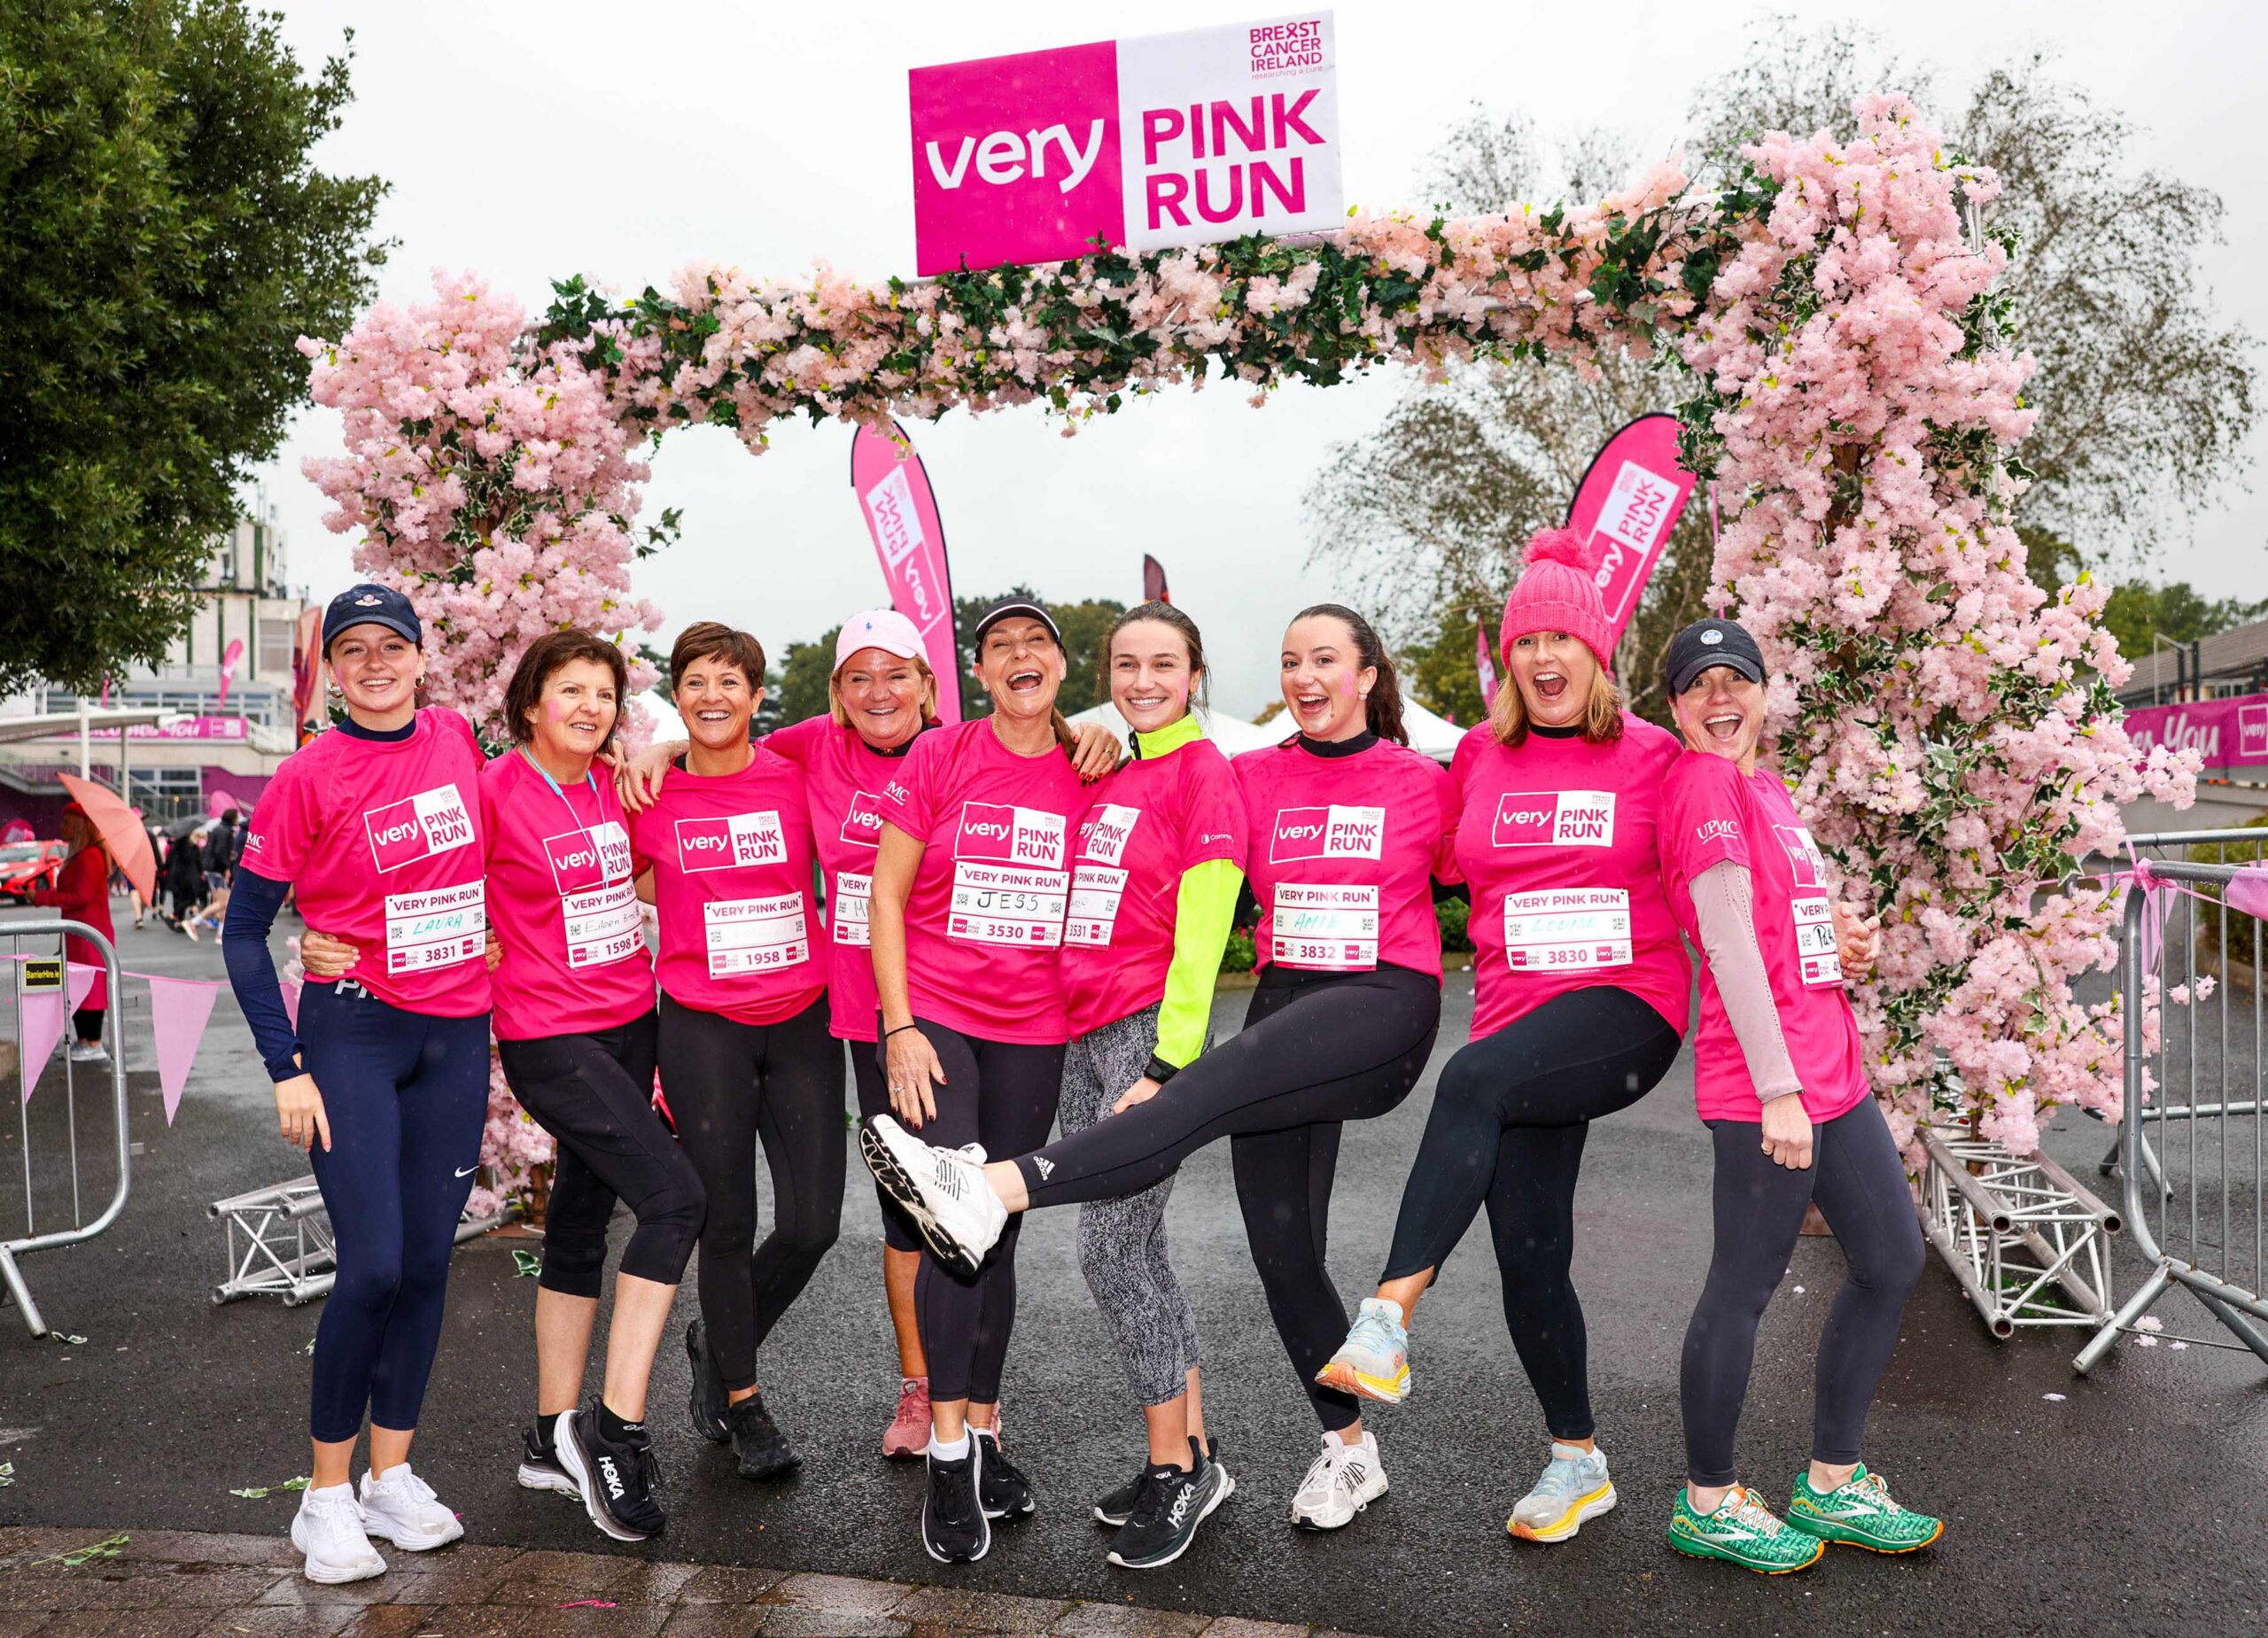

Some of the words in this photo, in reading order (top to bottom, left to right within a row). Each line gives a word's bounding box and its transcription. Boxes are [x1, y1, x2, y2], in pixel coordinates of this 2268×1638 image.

[1251, 38, 1321, 58] CANCER
[1252, 52, 1323, 72] IRELAND
[1142, 89, 1326, 165] PINK
[926, 119, 1104, 193] very
[1146, 158, 1306, 229] RUN
[1618, 477, 1655, 537] PINK
[1632, 491, 1666, 544] RUN
[1595, 542, 1623, 589] ery
[2243, 723, 2266, 739] very
[424, 806, 465, 830] PINK
[1502, 811, 1552, 827] very
[1560, 808, 1608, 822] PINK
[374, 819, 418, 847] very
[431, 823, 468, 847] RUN
[736, 829, 779, 846] PINK
[964, 821, 1010, 841] very
[1019, 827, 1060, 846] PINK
[1079, 822, 1096, 839] ery
[1095, 823, 1127, 842] PINK
[1278, 824, 1324, 841] very
[1332, 823, 1378, 837] PINK
[1559, 823, 1602, 838] RUN
[1696, 819, 1738, 839] UPMC
[601, 840, 628, 859] PINK
[682, 835, 727, 852] very
[739, 844, 778, 860] RUN
[1017, 844, 1056, 861] RUN
[1089, 838, 1116, 857] RUN
[1330, 837, 1371, 851] RUN
[555, 850, 595, 870] very
[608, 856, 630, 874] RUN
[843, 879, 866, 890] VERY
[965, 869, 998, 882] VERY
[1001, 873, 1032, 886] PINK
[1035, 877, 1061, 888] RUN
[1078, 873, 1096, 883] PINK
[1097, 873, 1119, 885] RUN
[394, 898, 427, 912] VERY
[431, 893, 456, 906] PINK
[459, 888, 479, 901] RUN
[571, 897, 602, 910] VERY
[606, 889, 626, 904] PINK
[977, 891, 1038, 912] JESS
[1279, 889, 1303, 901] VERY
[1307, 891, 1339, 902] PINK
[1342, 892, 1371, 902] RUN
[1513, 897, 1549, 908] VERY
[1552, 895, 1586, 905] PINK
[1590, 894, 1620, 904] RUN
[712, 906, 744, 917] VERY
[748, 903, 777, 914] PINK
[780, 898, 798, 911] RUN
[1800, 904, 1824, 916] VERY
[412, 914, 462, 935] LAURA
[585, 920, 619, 933] Eileen
[987, 924, 1023, 938] 3530
[1069, 924, 1086, 937] 3531
[1294, 912, 1339, 932] AMIE
[425, 945, 455, 963] 3831
[605, 938, 631, 955] 1598
[1300, 945, 1336, 959] 3832
[747, 951, 780, 965] 1958
[1548, 950, 1587, 964] 3830
[598, 1456, 625, 1500] HOKA
[1153, 1471, 1172, 1479] OKA
[1167, 1482, 1196, 1529] HOKA
